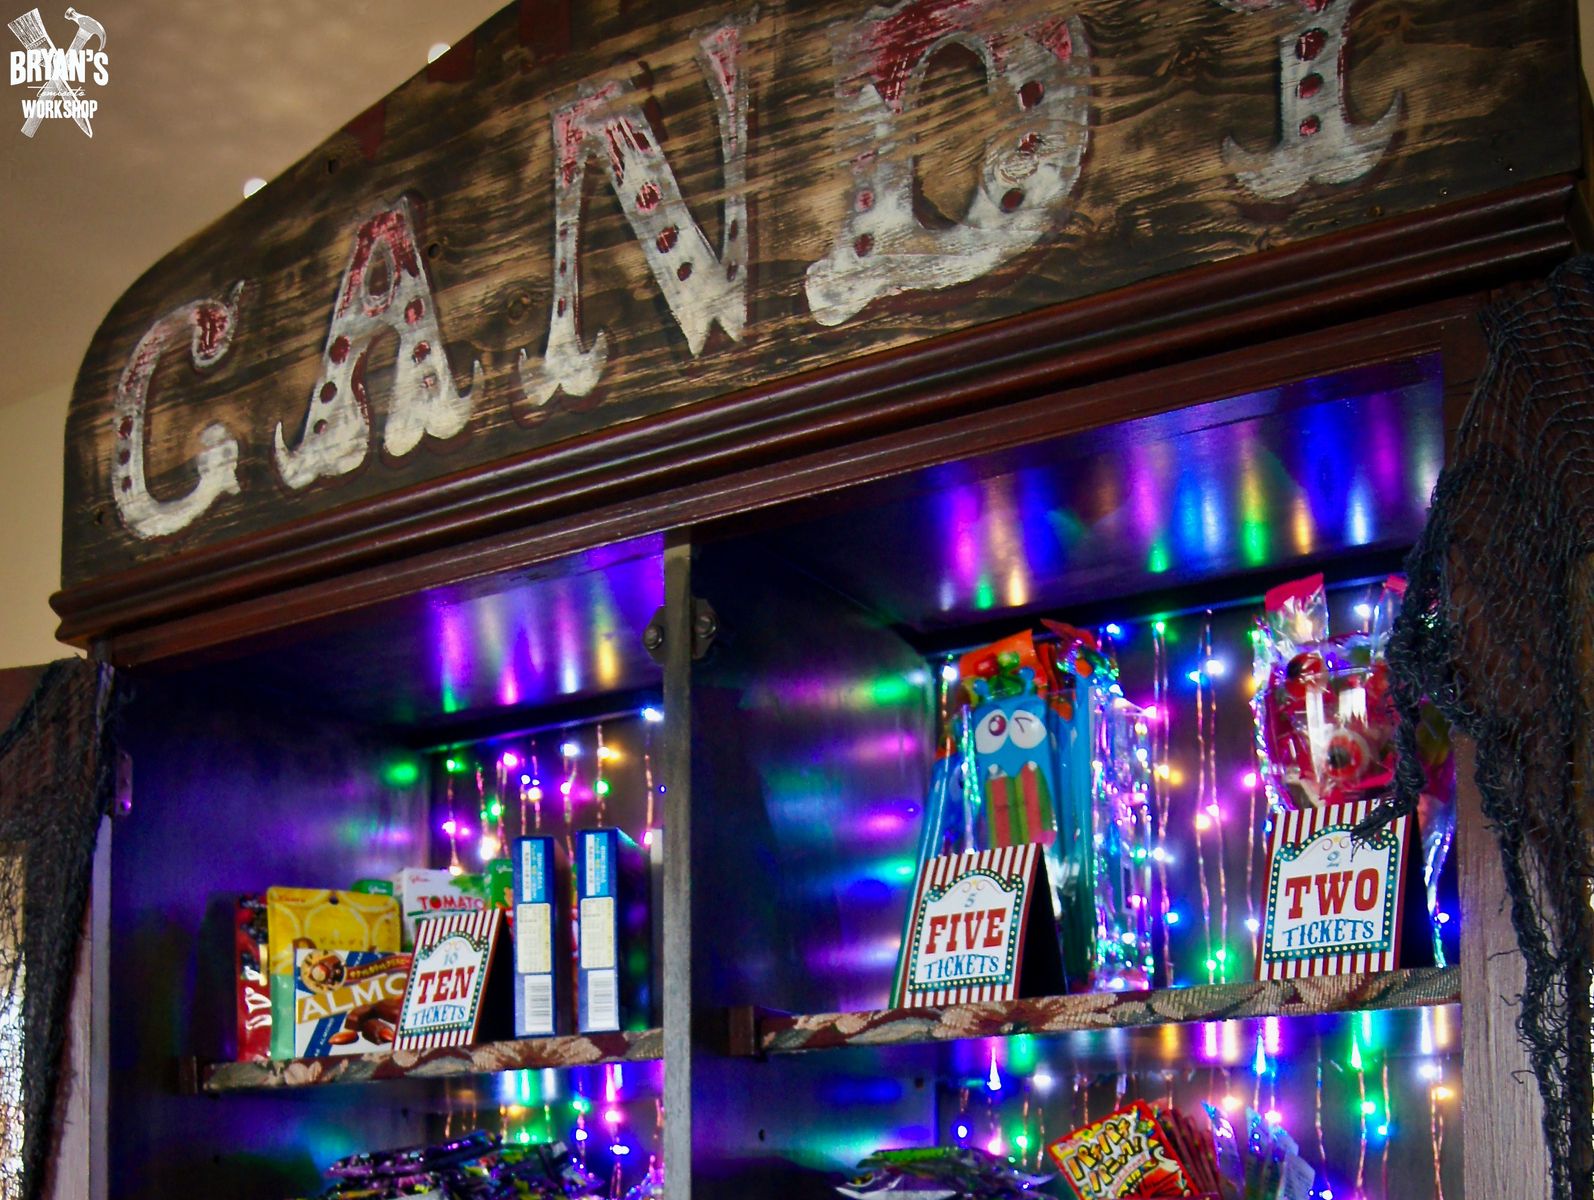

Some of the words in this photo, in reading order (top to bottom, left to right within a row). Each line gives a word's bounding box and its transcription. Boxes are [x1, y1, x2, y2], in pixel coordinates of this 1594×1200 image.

[417, 895, 486, 912] TOMATO
[1285, 868, 1379, 920] TWO
[925, 907, 1007, 954] FIVE
[1282, 918, 1374, 947] TICKETS
[924, 953, 999, 979] TICKETS
[417, 965, 476, 1004] TEN
[412, 1003, 466, 1025] TICKETS
